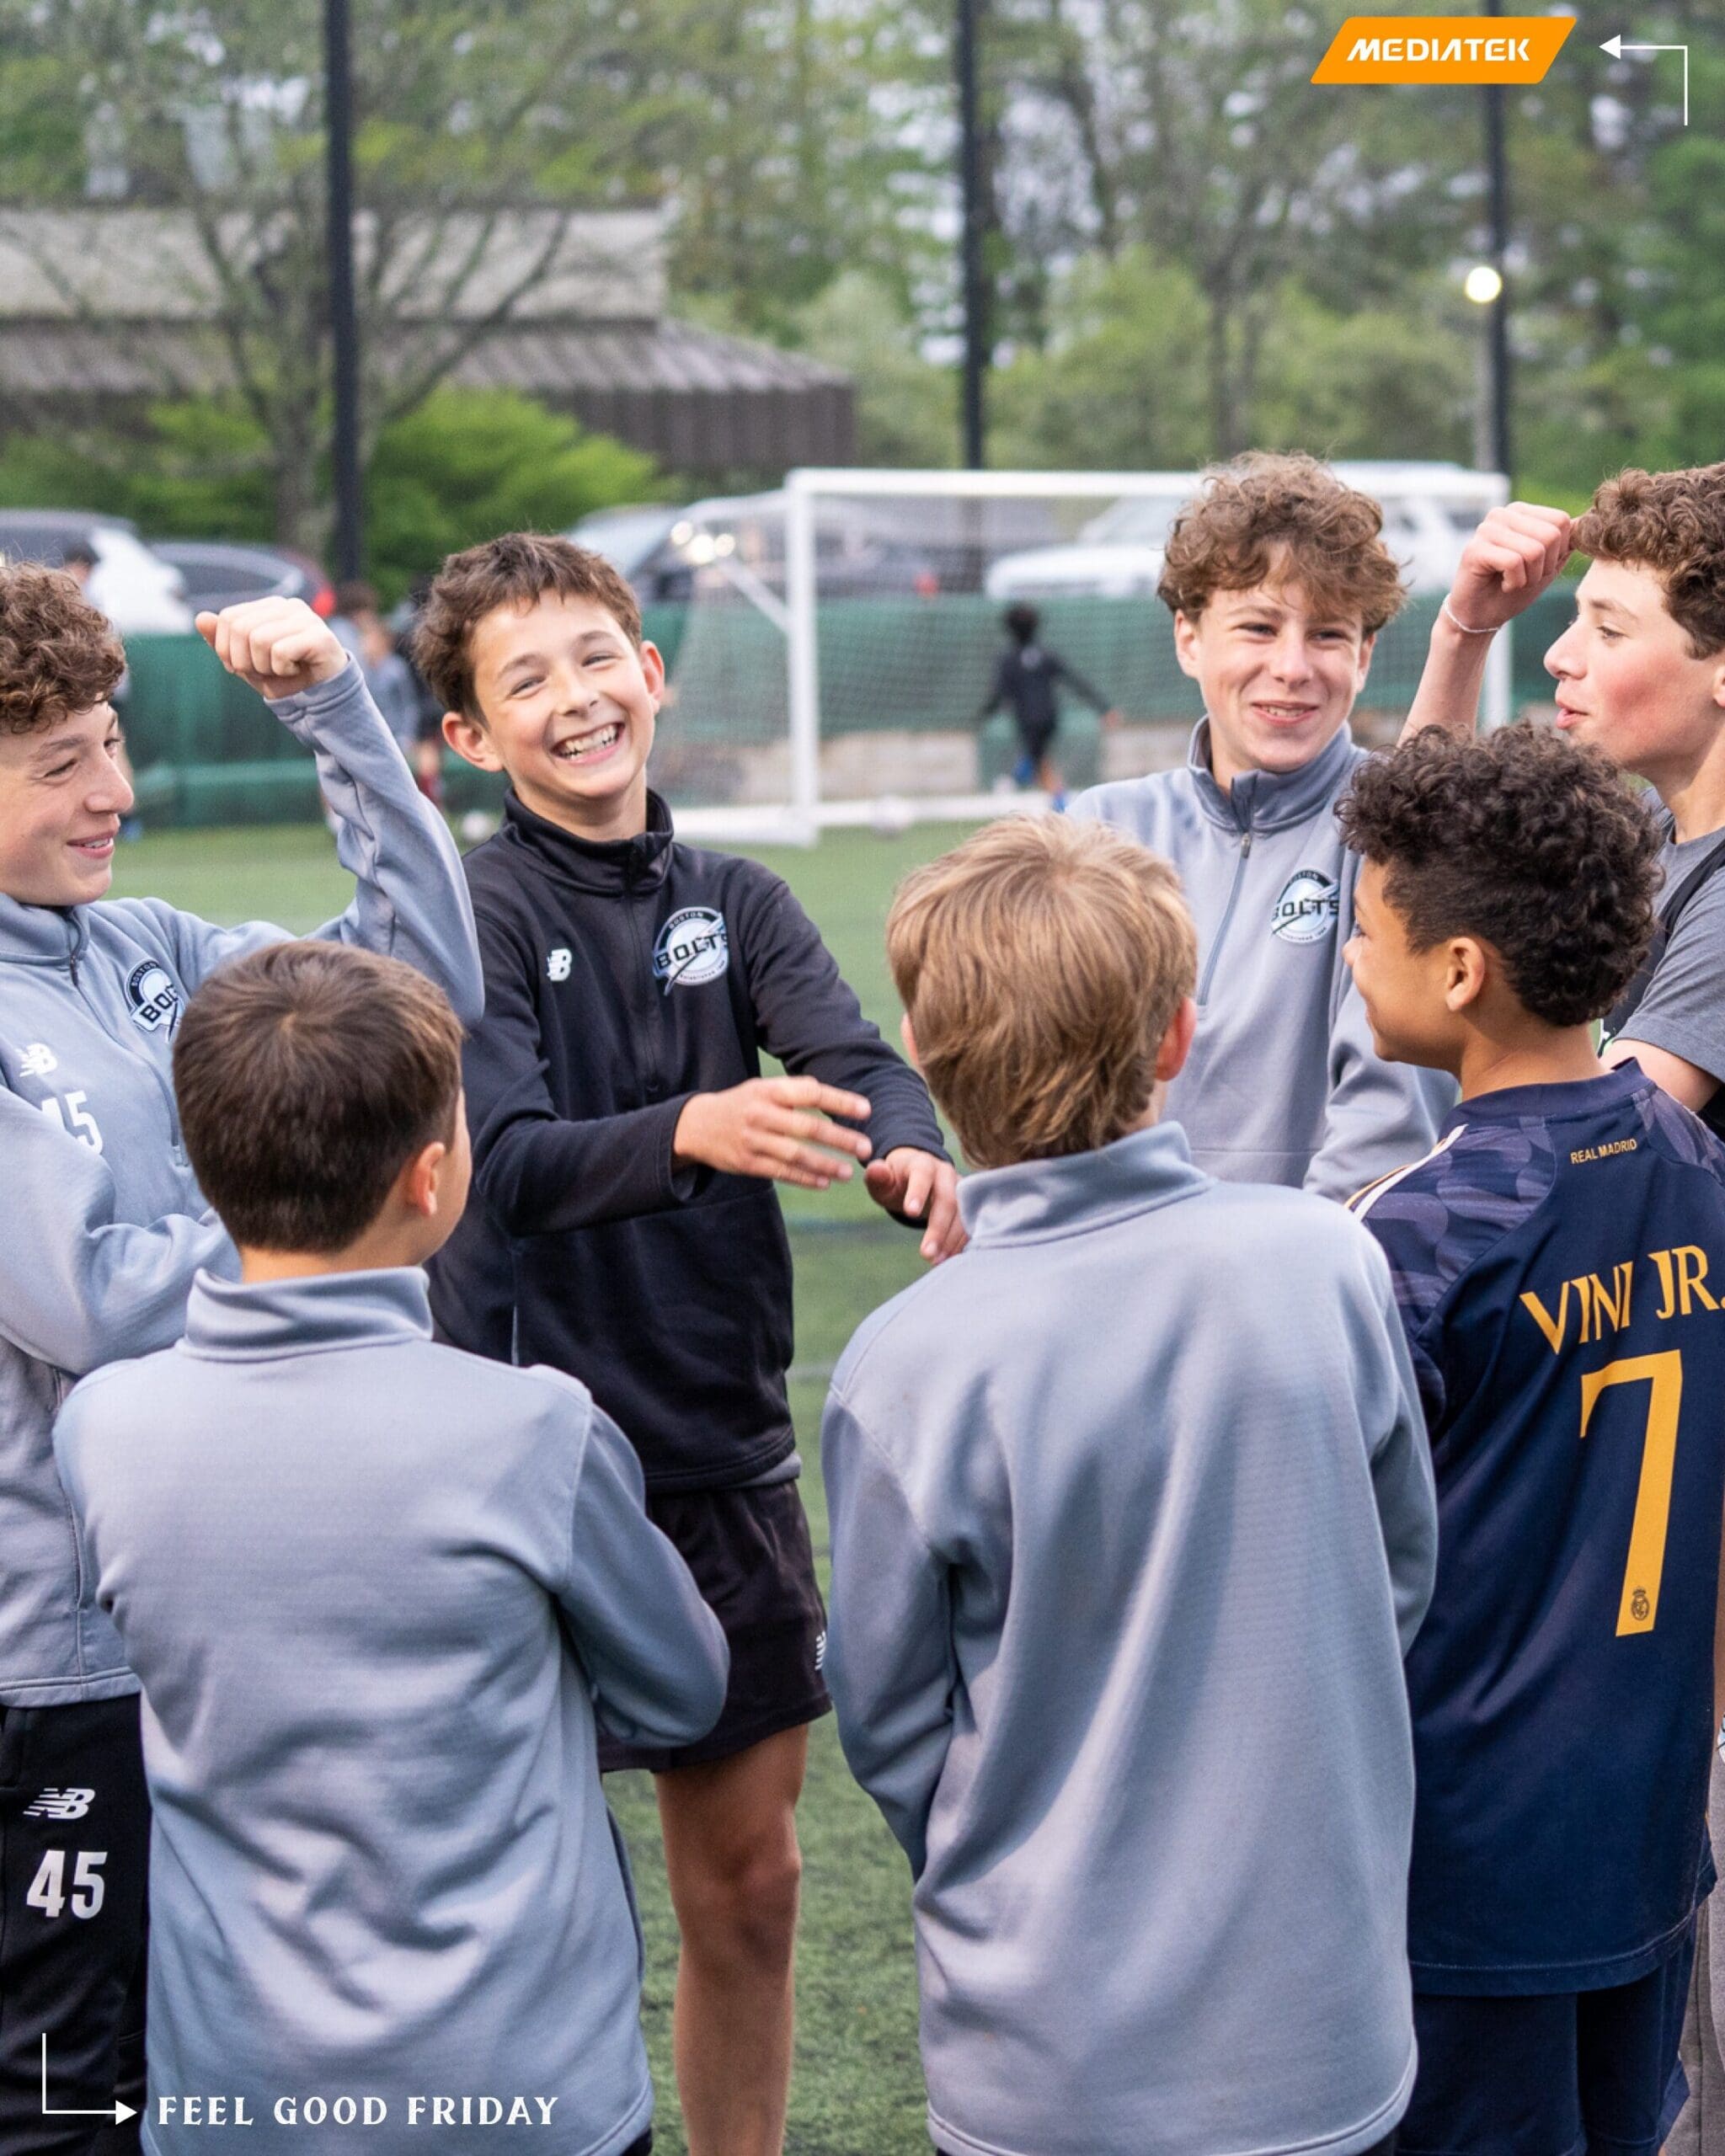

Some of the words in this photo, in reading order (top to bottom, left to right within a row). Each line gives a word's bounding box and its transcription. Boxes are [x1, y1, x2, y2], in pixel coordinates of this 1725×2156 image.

[1274, 898, 1339, 920] OLTS
[140, 984, 179, 1023] BOL
[1570, 1148, 1599, 1165] REAL
[1598, 1138, 1637, 1158] MADRID
[1519, 1261, 1633, 1355] VINI
[1580, 1348, 1683, 1636] 7
[26, 1849, 108, 1919] 45
